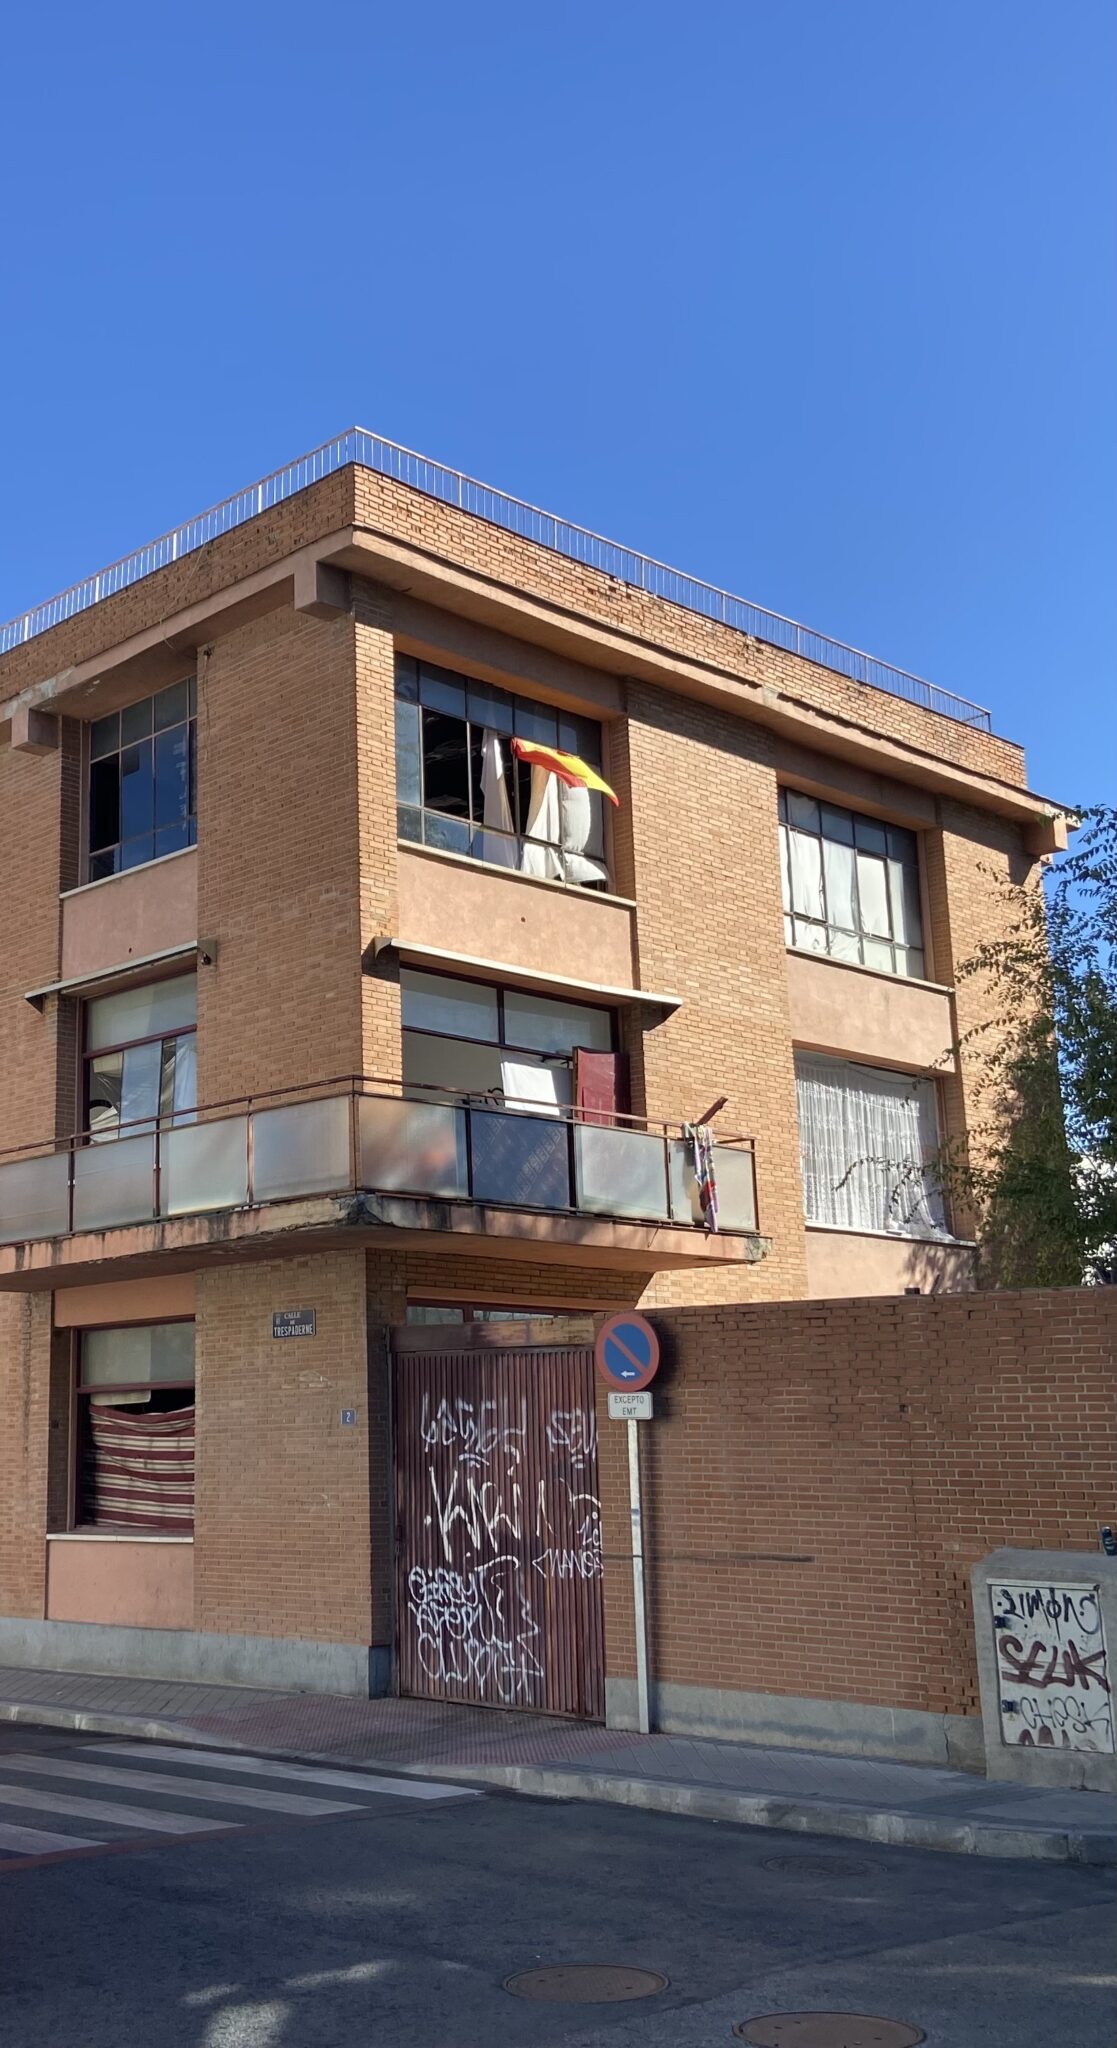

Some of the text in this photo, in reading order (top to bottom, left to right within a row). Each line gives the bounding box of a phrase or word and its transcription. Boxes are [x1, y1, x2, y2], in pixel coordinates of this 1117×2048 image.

[284, 1311, 301, 1319] CALLE
[274, 1324, 313, 1337] TRESPADERNE
[614, 1395, 644, 1404] EXCEPTO
[622, 1407, 637, 1416] EMT
[346, 1411, 351, 1423] 2
